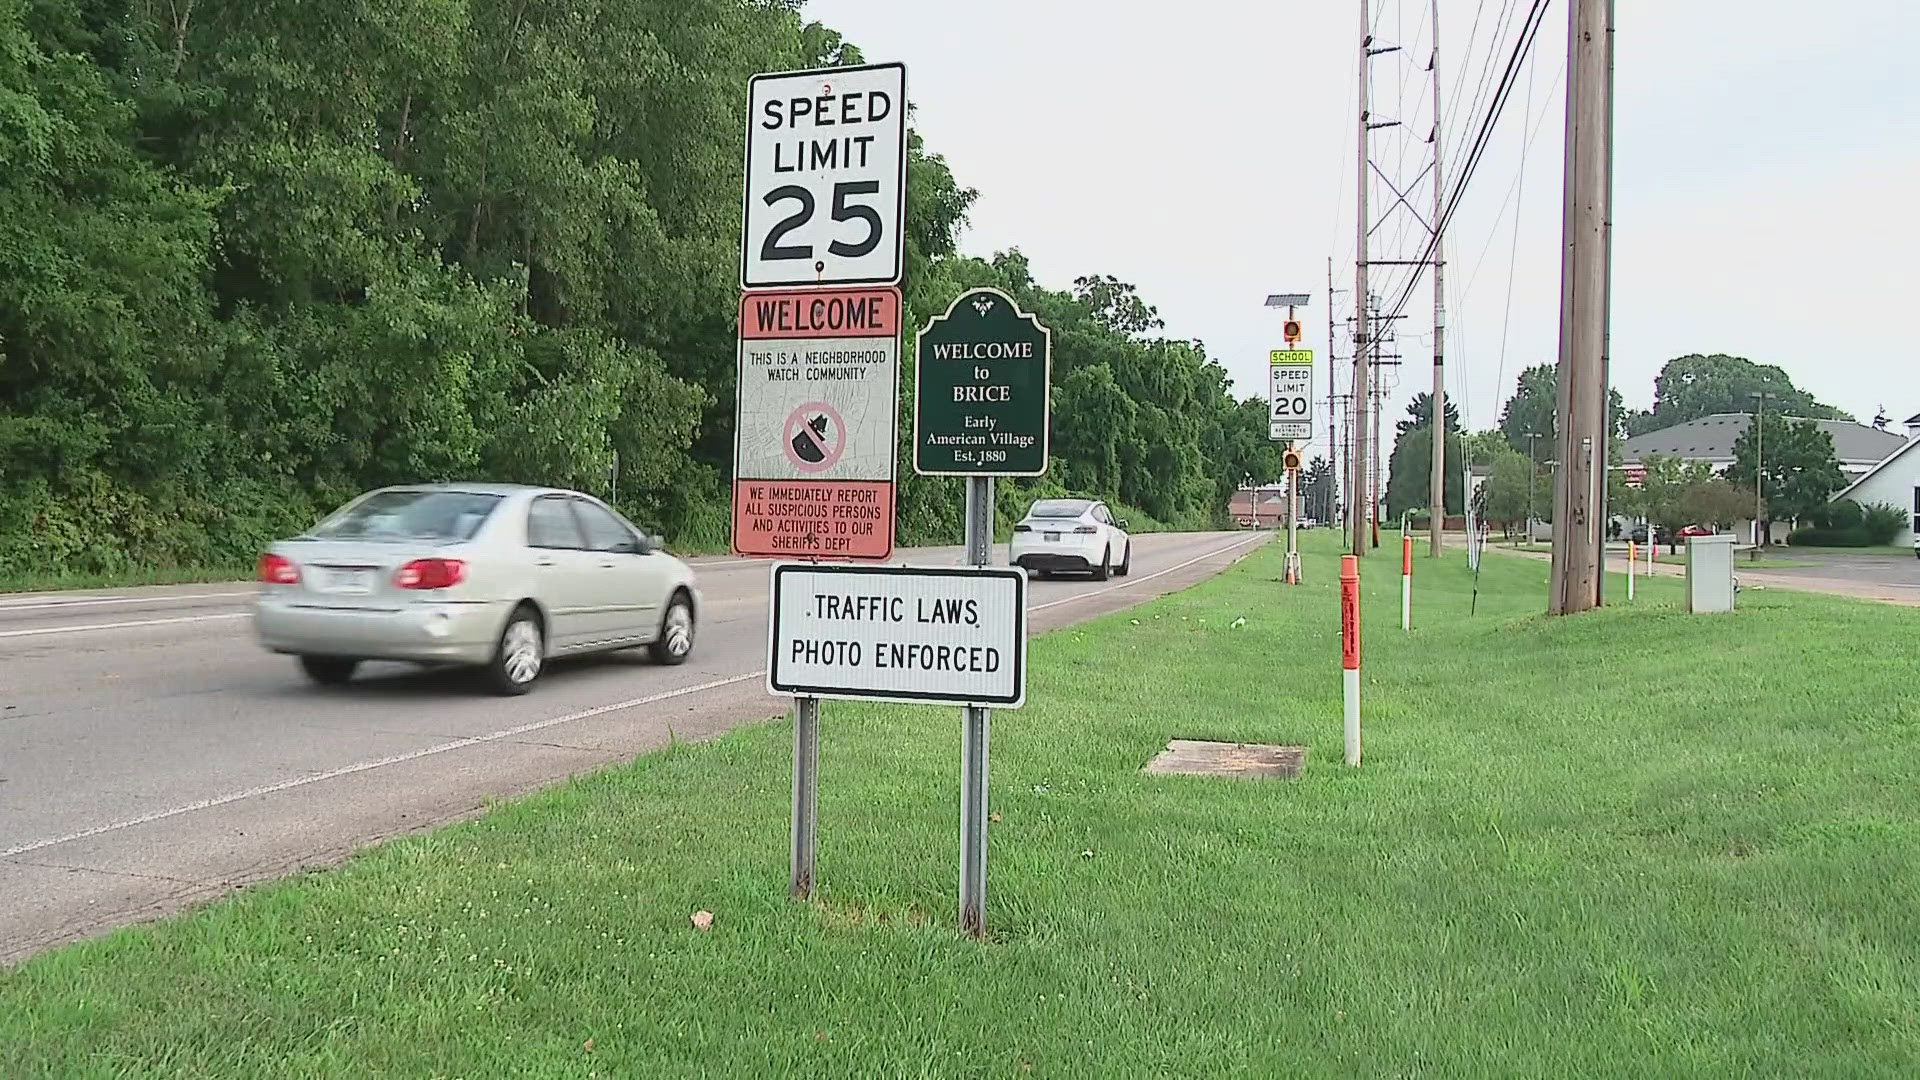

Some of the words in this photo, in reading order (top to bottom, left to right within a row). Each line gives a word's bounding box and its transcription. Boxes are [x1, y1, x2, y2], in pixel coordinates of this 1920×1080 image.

[762, 91, 891, 129] SPEED
[774, 136, 875, 173] LIMIT
[760, 180, 883, 261] 25
[757, 297, 884, 332] WELCOME
[751, 352, 772, 365] THIS
[777, 352, 786, 365] IS
[791, 352, 798, 365] A
[805, 350, 886, 365] NEIGHBORHOOD
[933, 342, 1033, 360] WELCOME
[1272, 353, 1310, 361] SCHOOL
[768, 368, 799, 381] WATCH
[806, 367, 867, 381] COMMUNITY
[974, 366, 990, 380] to
[1273, 371, 1309, 380] SPEED
[953, 385, 1011, 402] BRICE
[1276, 384, 1305, 393] LIMIT
[1275, 397, 1307, 415] 20
[965, 415, 997, 431] Early
[927, 432, 986, 445] American
[990, 432, 1035, 448] Village
[954, 450, 976, 462] Est.
[979, 450, 1007, 462] 1880
[750, 487, 764, 500] WE
[769, 487, 833, 502] IMMEDIATELY
[838, 489, 878, 503] REPORT
[745, 503, 763, 516] ALL
[768, 503, 828, 518] SUSPICIOUS
[833, 505, 881, 520] PERSONS
[752, 519, 773, 532] AND
[778, 519, 830, 534] ACTIVITIES
[835, 521, 847, 534] TO
[852, 522, 873, 536] OUR
[825, 537, 852, 551] DEPT
[814, 594, 904, 622] TRAFFIC
[917, 598, 979, 625] LAWS
[792, 639, 862, 667] PHOTO
[875, 643, 1000, 673] ENFORCED
